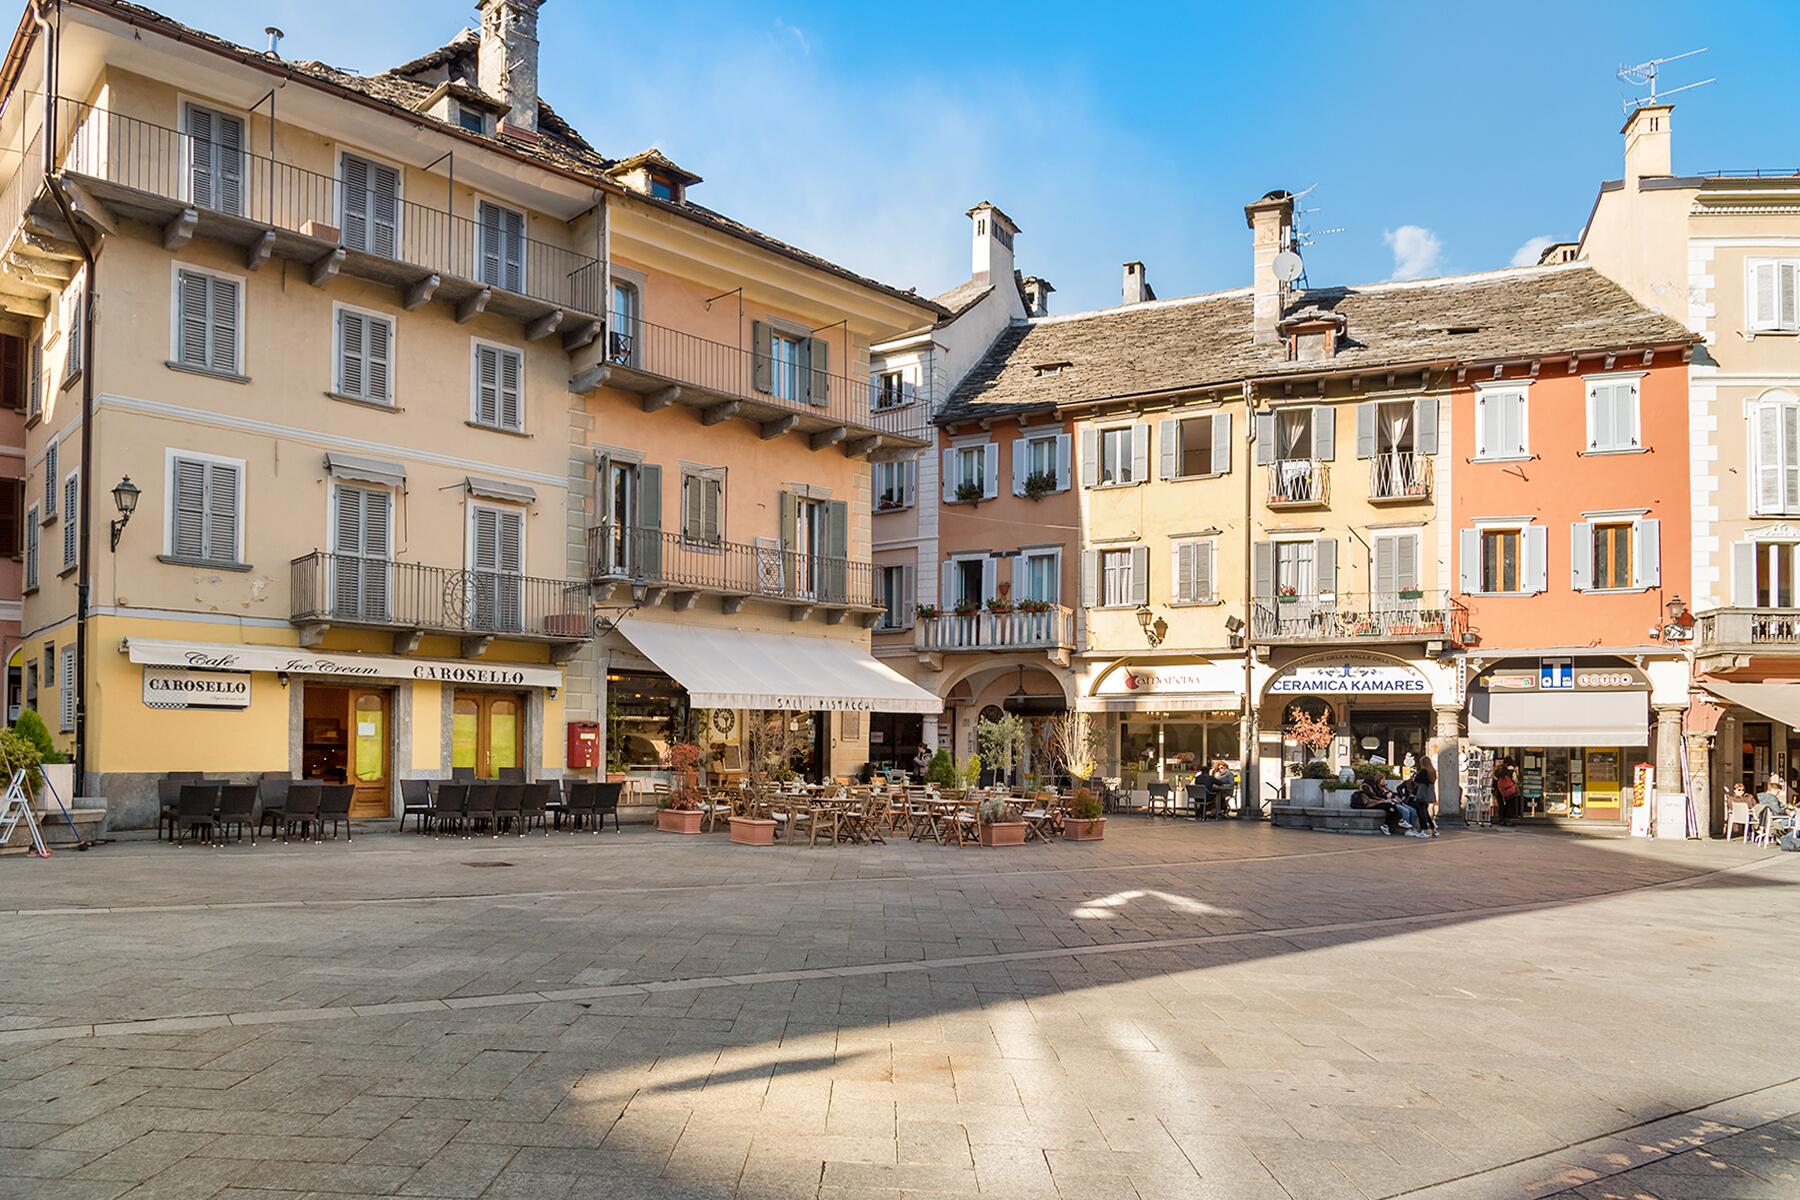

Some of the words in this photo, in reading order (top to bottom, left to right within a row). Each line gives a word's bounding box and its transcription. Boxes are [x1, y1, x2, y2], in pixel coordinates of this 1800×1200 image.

[184, 651, 240, 667] Café
[315, 660, 381, 675] Cream
[413, 666, 524, 684] CAROSELLO
[149, 679, 246, 694] CAROSELLO
[1272, 680, 1348, 691] CERAMICA
[1351, 680, 1424, 691] KAMARES
